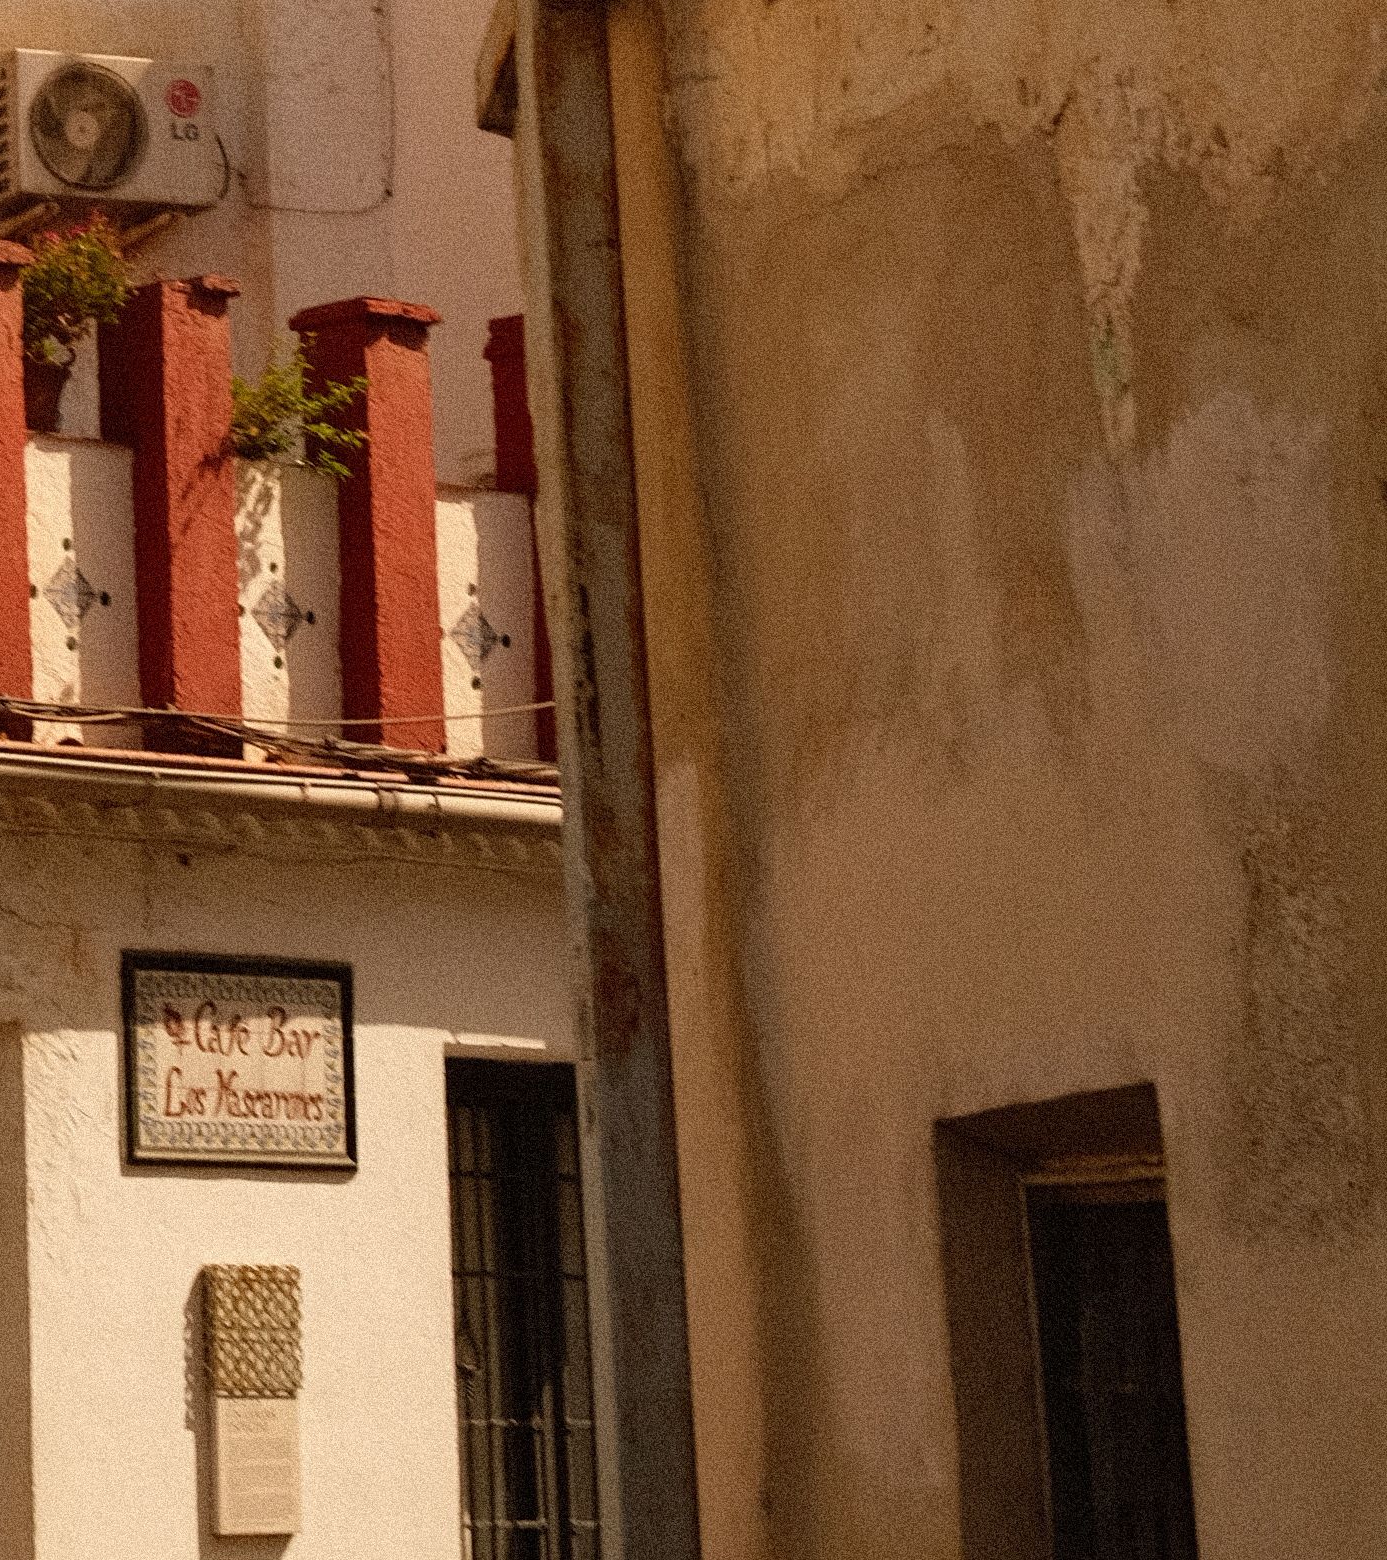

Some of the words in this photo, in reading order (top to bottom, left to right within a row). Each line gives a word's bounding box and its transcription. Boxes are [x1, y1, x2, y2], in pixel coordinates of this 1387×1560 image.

[170, 122, 199, 141] LG
[262, 1006, 321, 1059] Bar
[163, 1065, 207, 1119] Los
